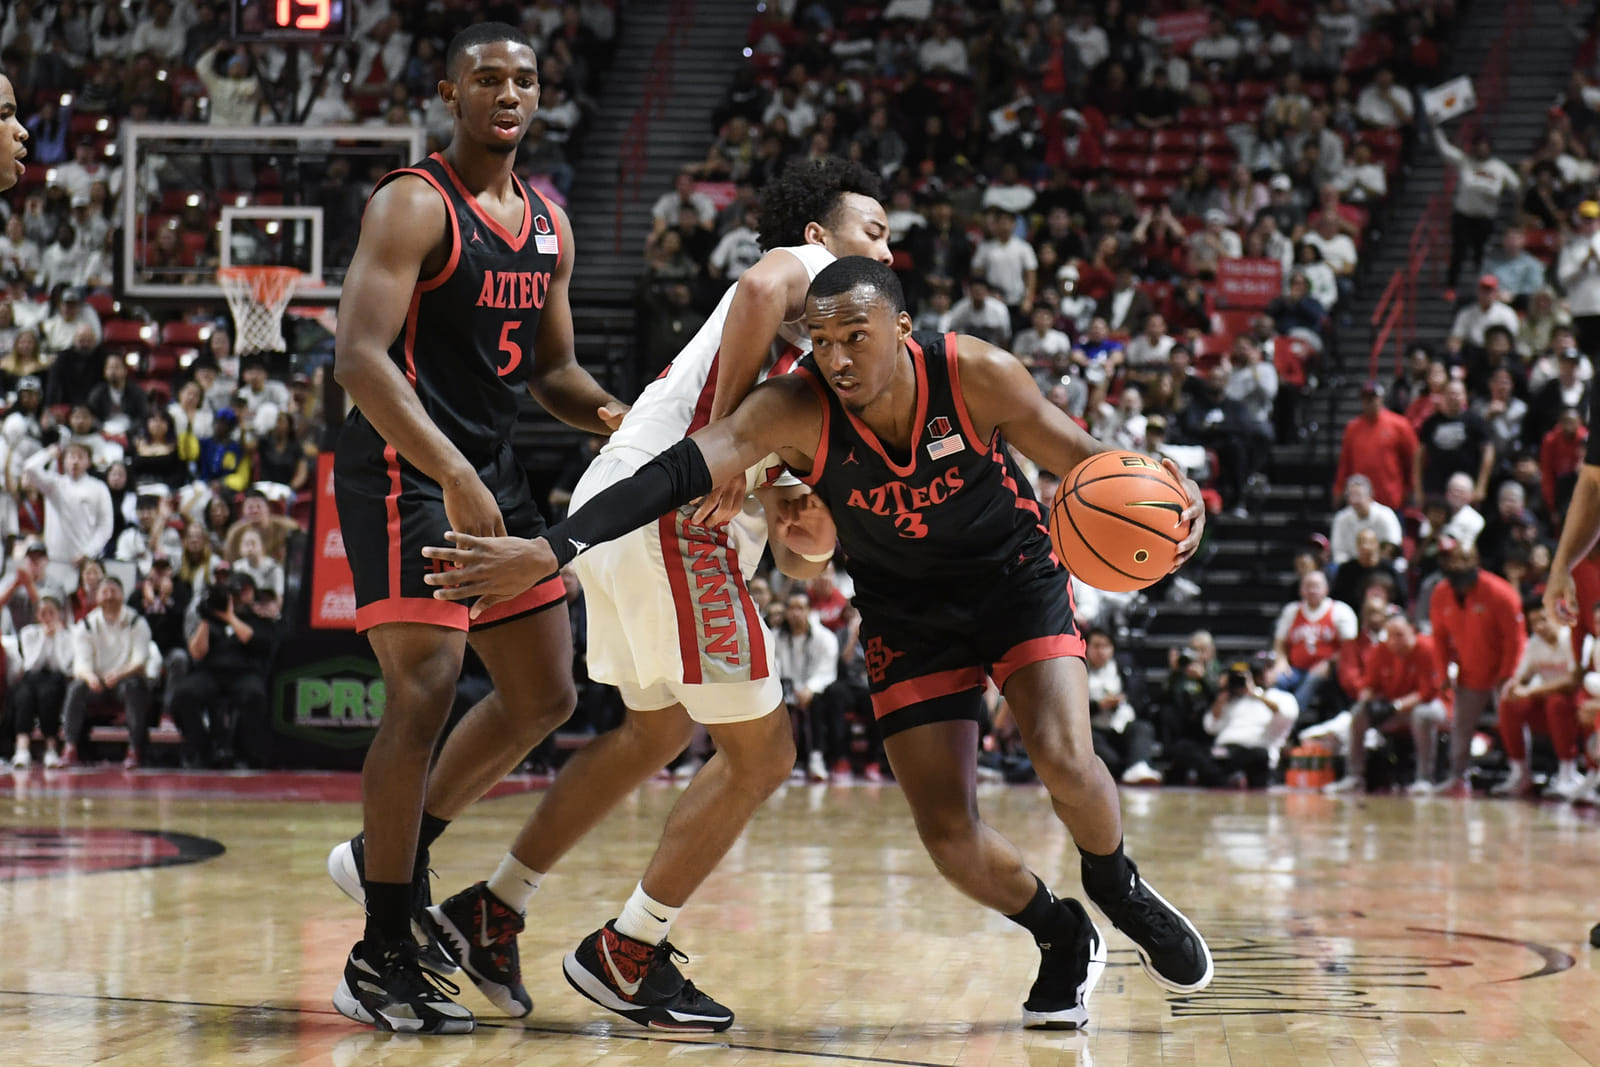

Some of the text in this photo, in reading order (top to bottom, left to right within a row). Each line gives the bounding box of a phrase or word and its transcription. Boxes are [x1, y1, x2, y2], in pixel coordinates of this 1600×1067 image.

[497, 321, 523, 377] 5
[847, 466, 965, 516] AZTECS
[894, 512, 929, 539] 3
